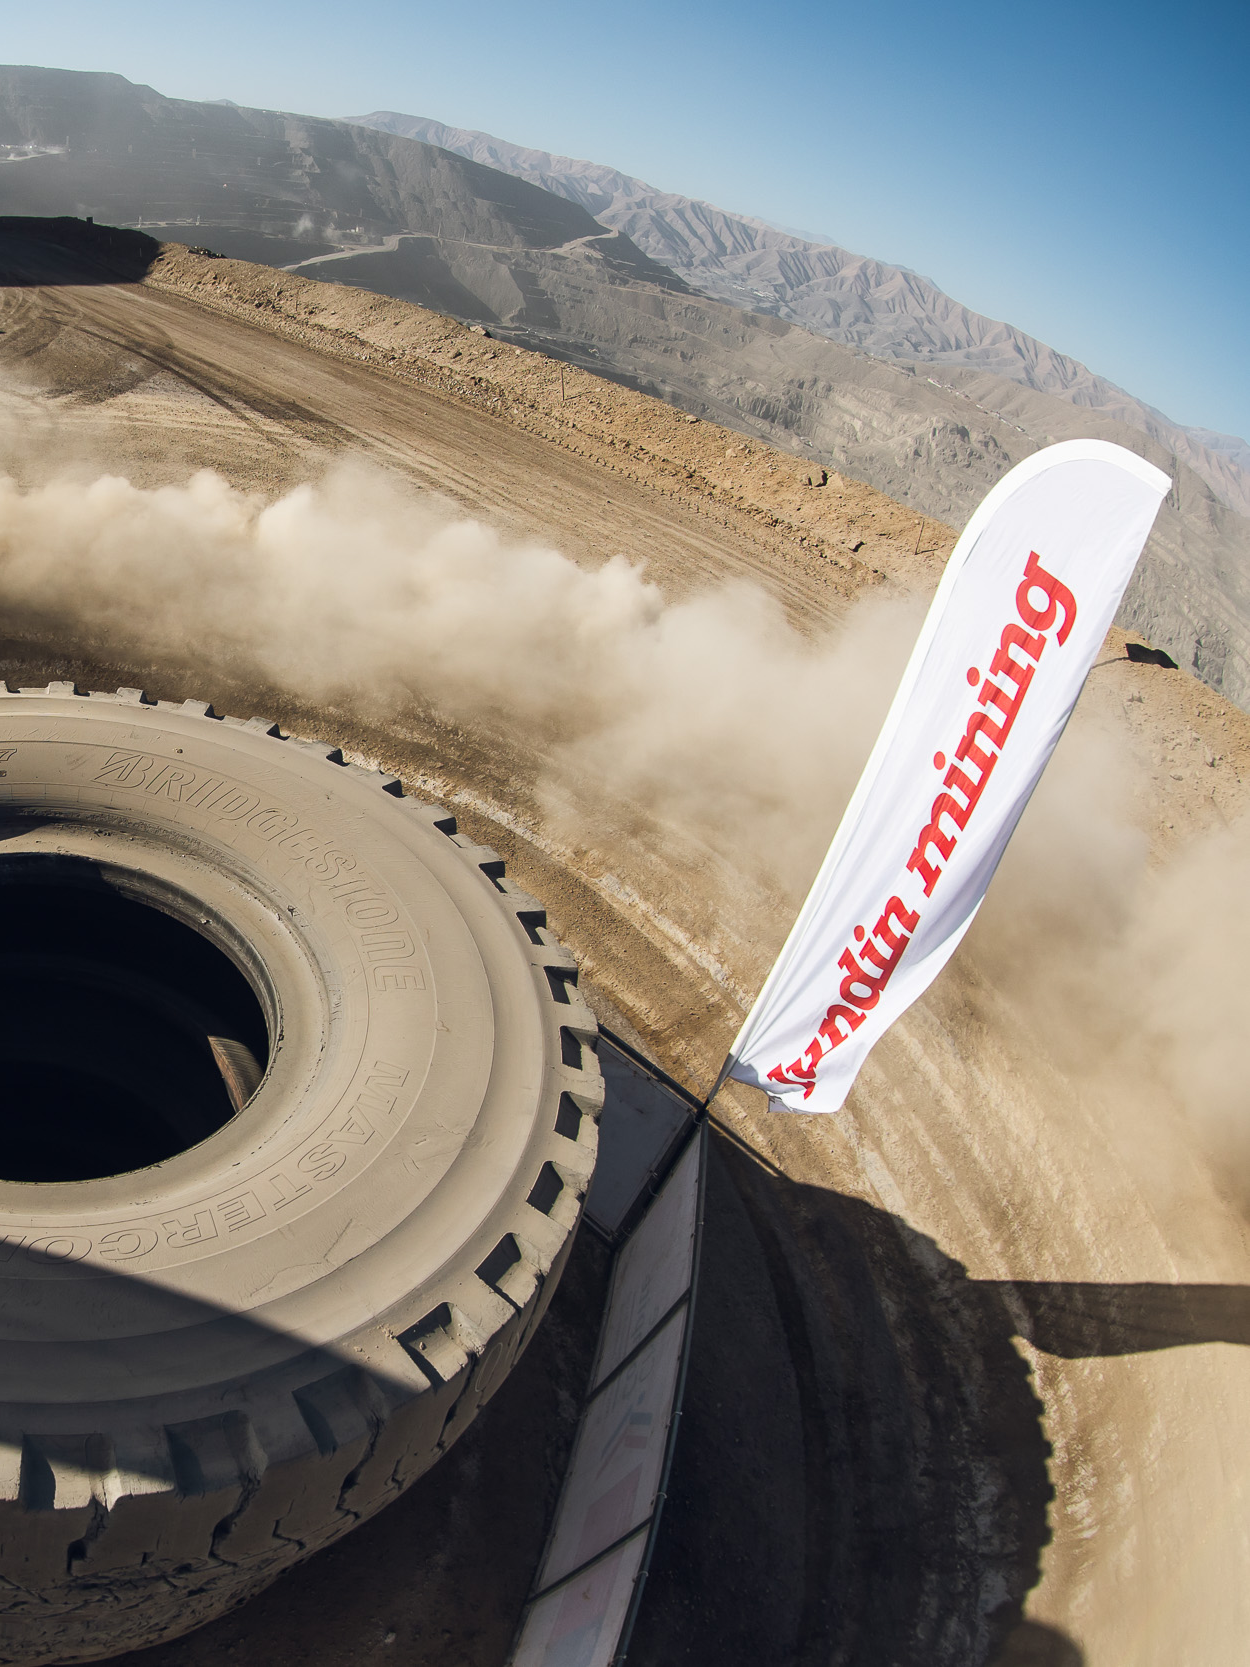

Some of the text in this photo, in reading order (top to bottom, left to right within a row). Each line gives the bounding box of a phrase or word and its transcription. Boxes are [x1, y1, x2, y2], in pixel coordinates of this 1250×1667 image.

[90, 750, 426, 993] BRIDGESTONE
[766, 549, 1078, 1100] lundin mining
